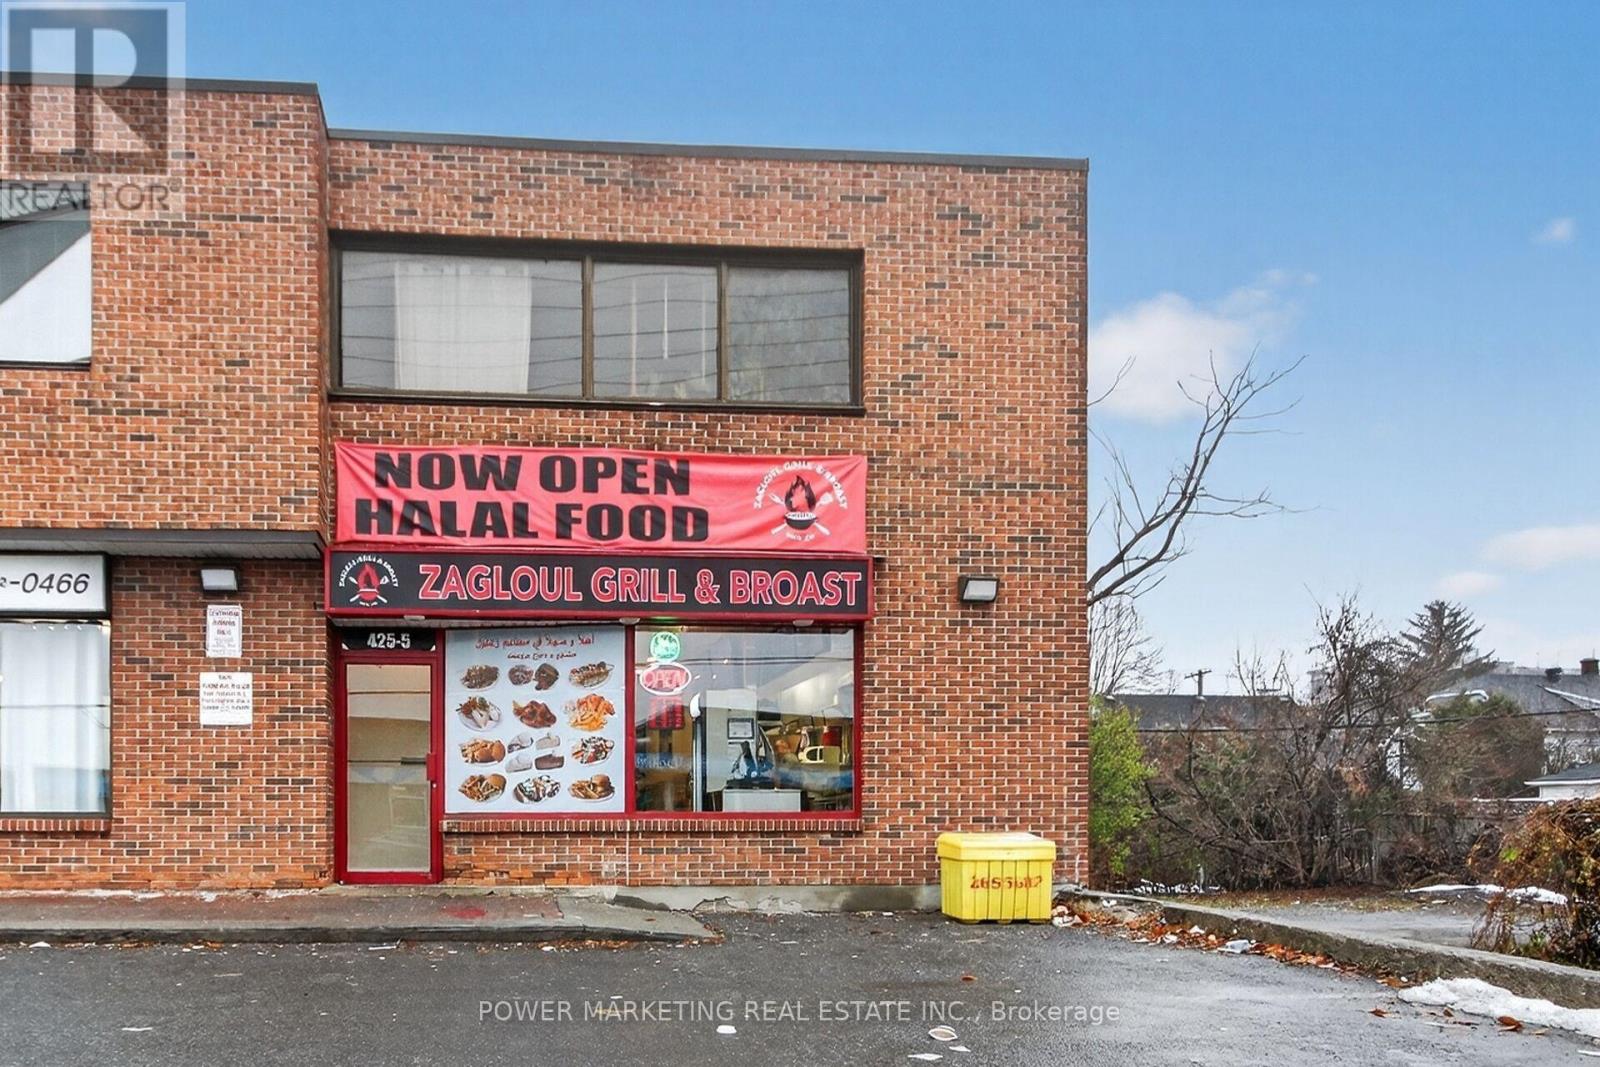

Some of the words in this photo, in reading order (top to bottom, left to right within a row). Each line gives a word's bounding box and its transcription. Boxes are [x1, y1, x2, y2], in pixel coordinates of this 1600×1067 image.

[374, 452, 522, 491] NOW
[539, 455, 690, 495] OPEN
[355, 498, 538, 539] HALAL
[556, 503, 709, 542] FOOD
[418, 564, 582, 601] ZAGLOUL
[591, 567, 685, 603] GRILL
[694, 569, 721, 604] &
[729, 570, 862, 605] BROAST
[367, 633, 411, 649] 425-5
[643, 669, 687, 690] OPEN
